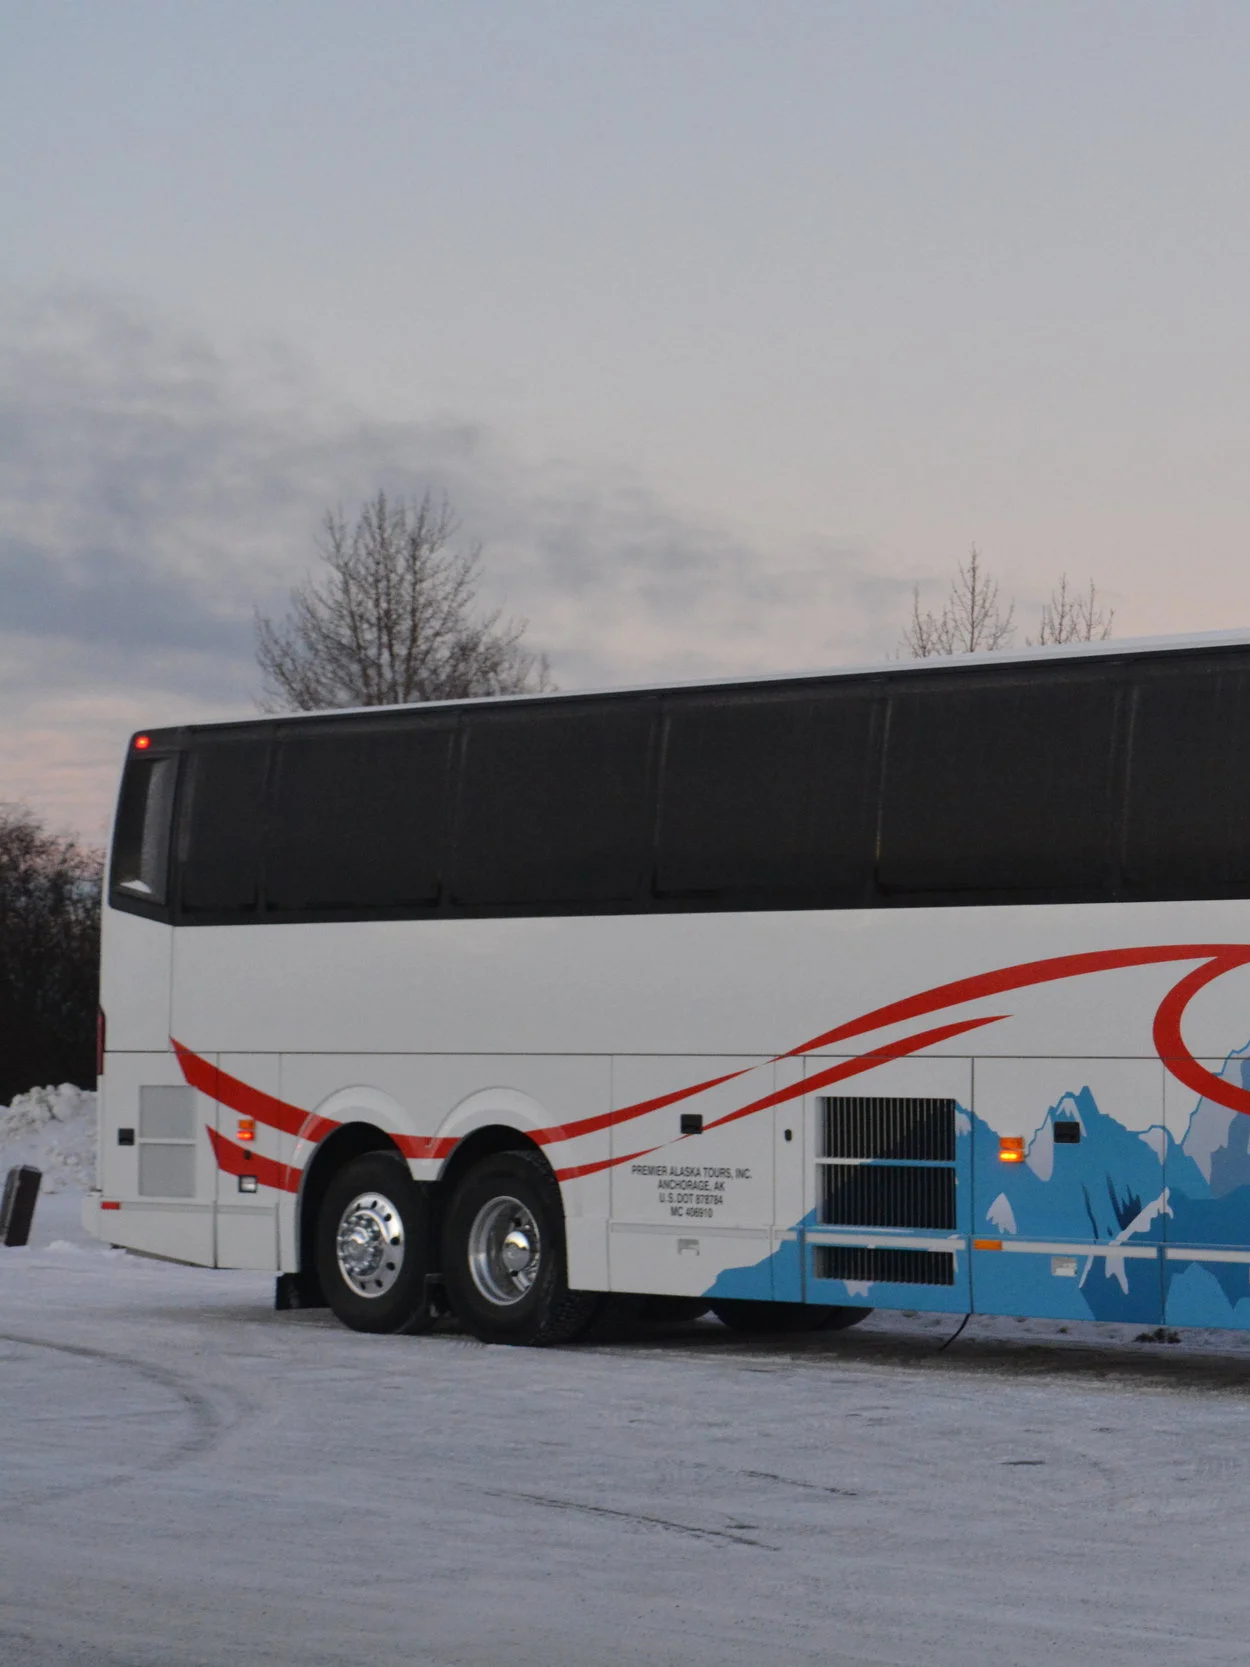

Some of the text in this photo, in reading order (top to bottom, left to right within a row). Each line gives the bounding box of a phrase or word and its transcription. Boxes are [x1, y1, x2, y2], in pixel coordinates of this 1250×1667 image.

[631, 1165, 752, 1180] PREMIER ALASKA TOURS, INC.
[714, 1181, 725, 1191] AK
[671, 1206, 683, 1217] MC
